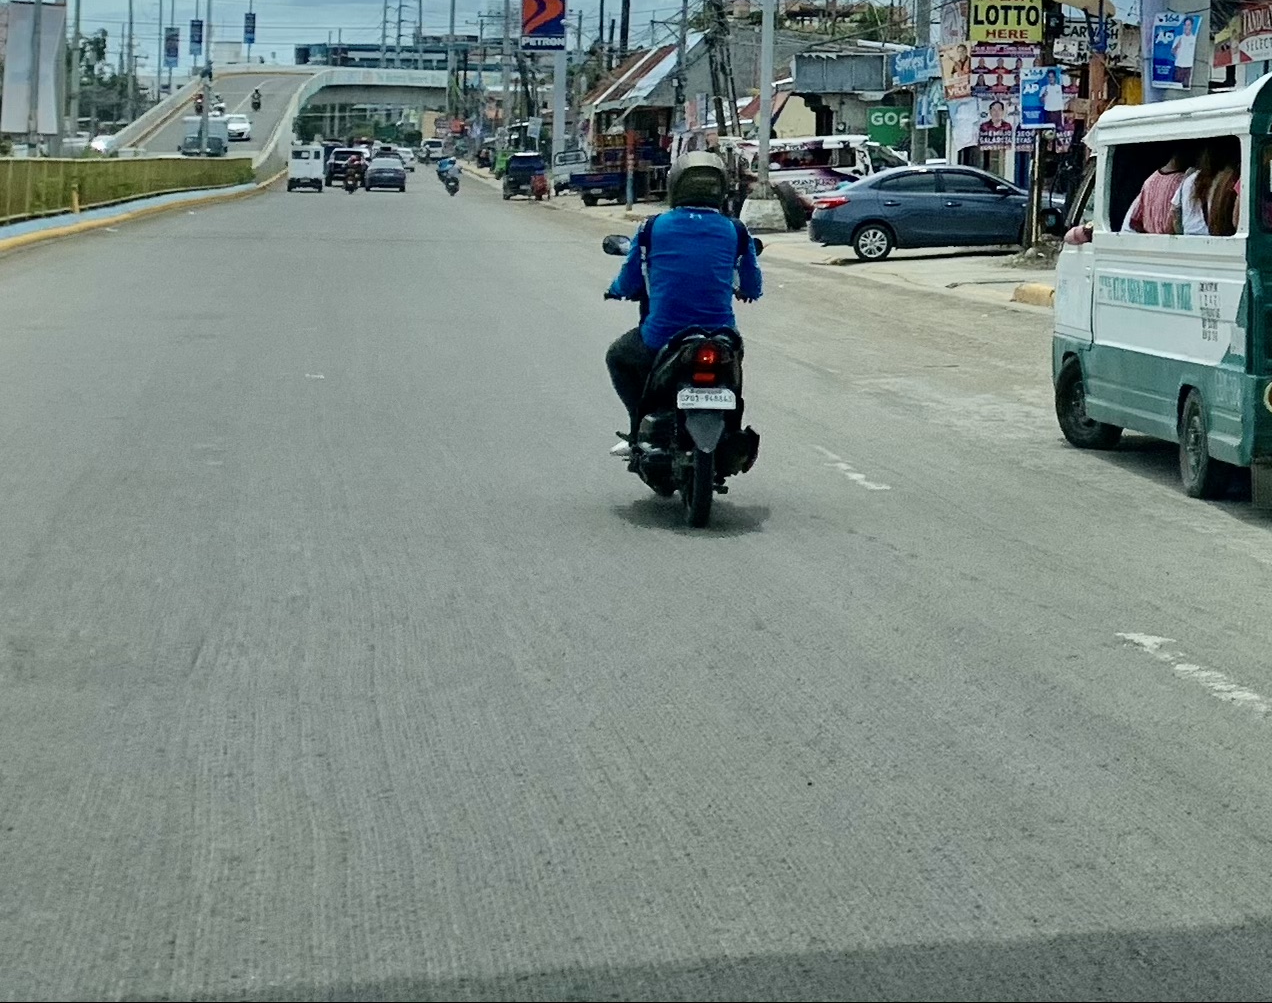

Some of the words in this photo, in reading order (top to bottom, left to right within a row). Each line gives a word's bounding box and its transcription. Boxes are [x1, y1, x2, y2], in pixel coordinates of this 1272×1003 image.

[973, 4, 1040, 27] LOTTO
[985, 29, 1029, 40] HERE
[521, 36, 565, 47] PETRON
